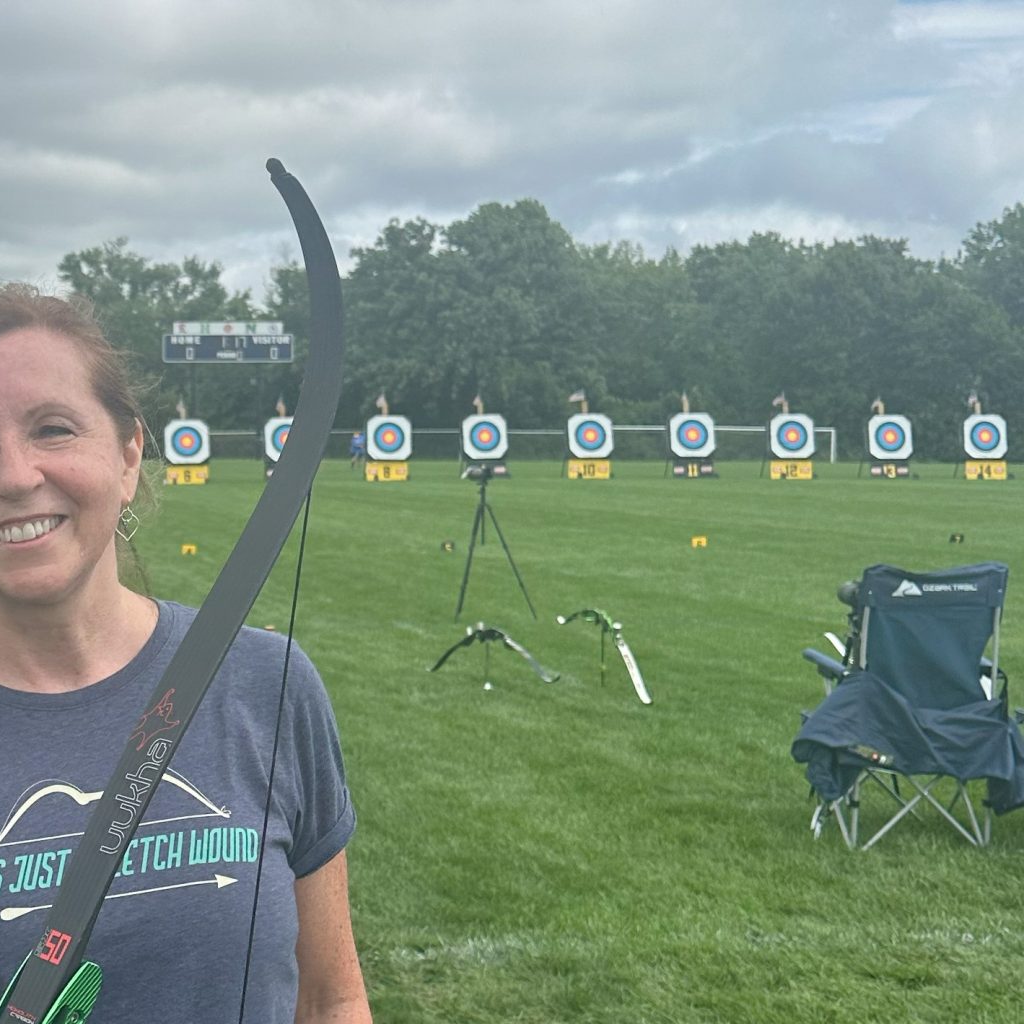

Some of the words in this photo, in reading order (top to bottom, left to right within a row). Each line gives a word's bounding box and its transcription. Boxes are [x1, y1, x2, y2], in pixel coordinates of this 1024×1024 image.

[171, 336, 201, 345] HOME
[252, 336, 290, 345] VISITOR
[583, 464, 595, 476] 10
[688, 463, 698, 477] 11
[785, 464, 798, 477] 12
[100, 738, 173, 854] uukha
[8, 849, 72, 894] JUST
[188, 827, 260, 865] WOUND
